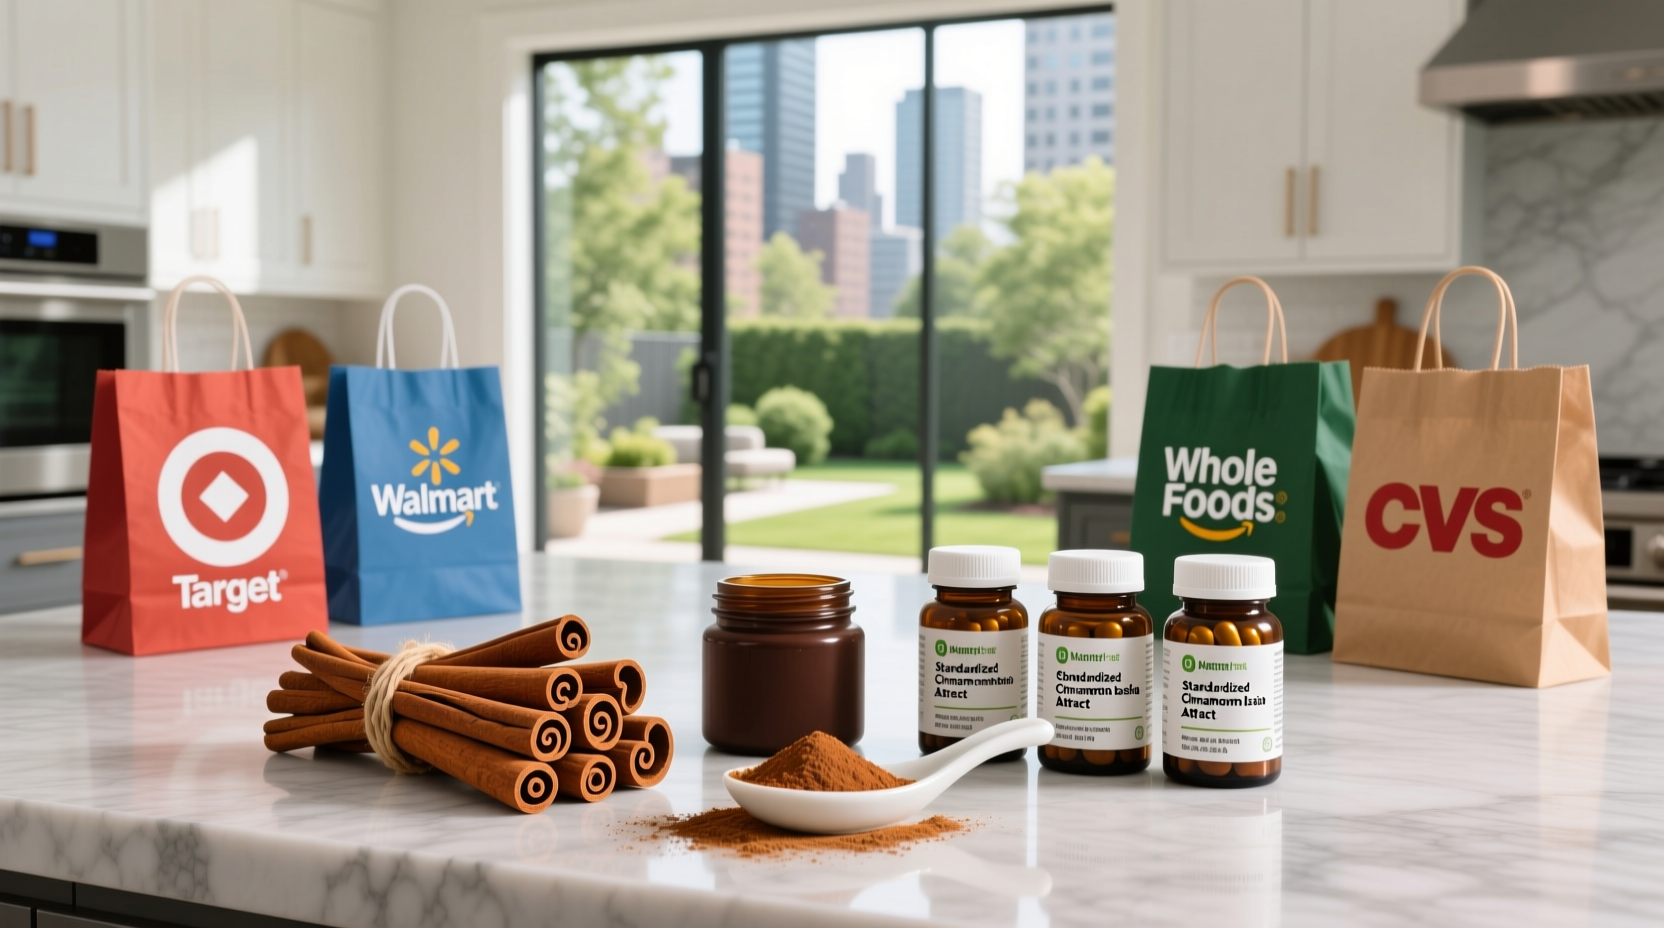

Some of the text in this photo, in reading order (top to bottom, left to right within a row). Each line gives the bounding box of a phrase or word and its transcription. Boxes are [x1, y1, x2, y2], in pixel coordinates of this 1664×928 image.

[1164, 446, 1277, 487] Whole
[371, 481, 499, 516] Walmart
[1162, 483, 1275, 523] Foods
[1365, 482, 1523, 559] CVS
[172, 570, 282, 613] Target
